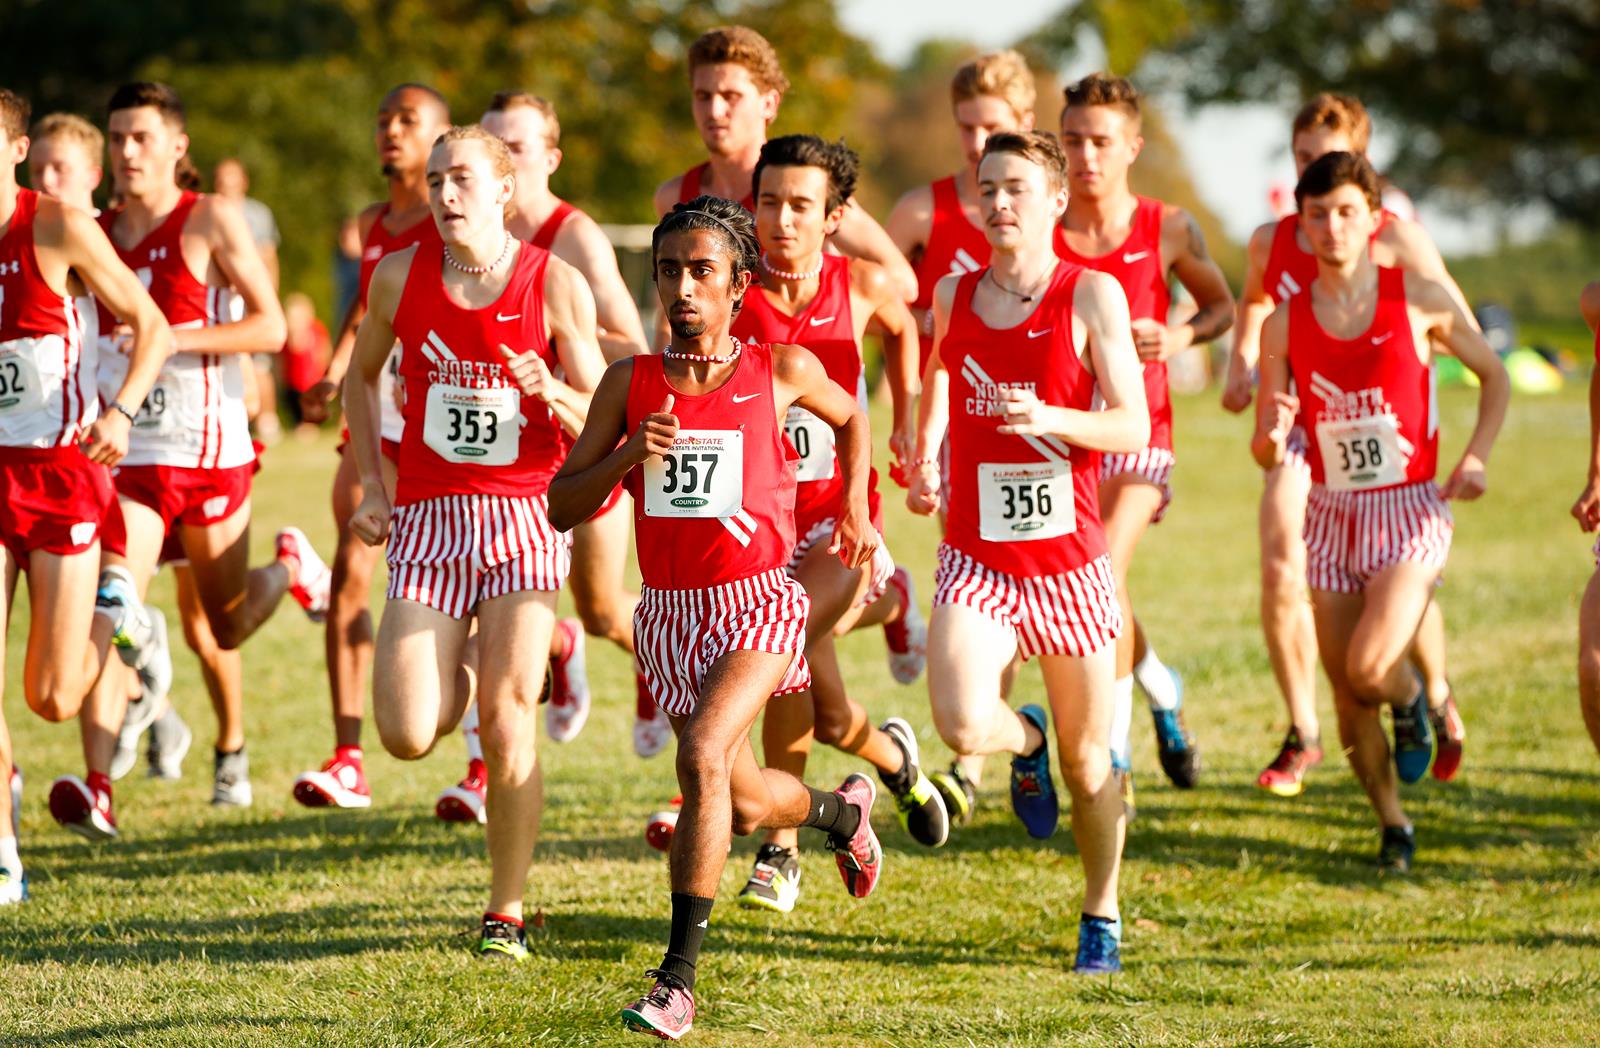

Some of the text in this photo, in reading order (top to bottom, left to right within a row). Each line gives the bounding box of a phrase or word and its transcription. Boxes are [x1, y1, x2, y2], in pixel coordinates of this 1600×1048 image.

[436, 359, 502, 377] NORTH
[447, 408, 497, 445] 353
[1336, 438, 1382, 471] 358
[662, 453, 718, 494] 357
[1001, 484, 1052, 519] 356
